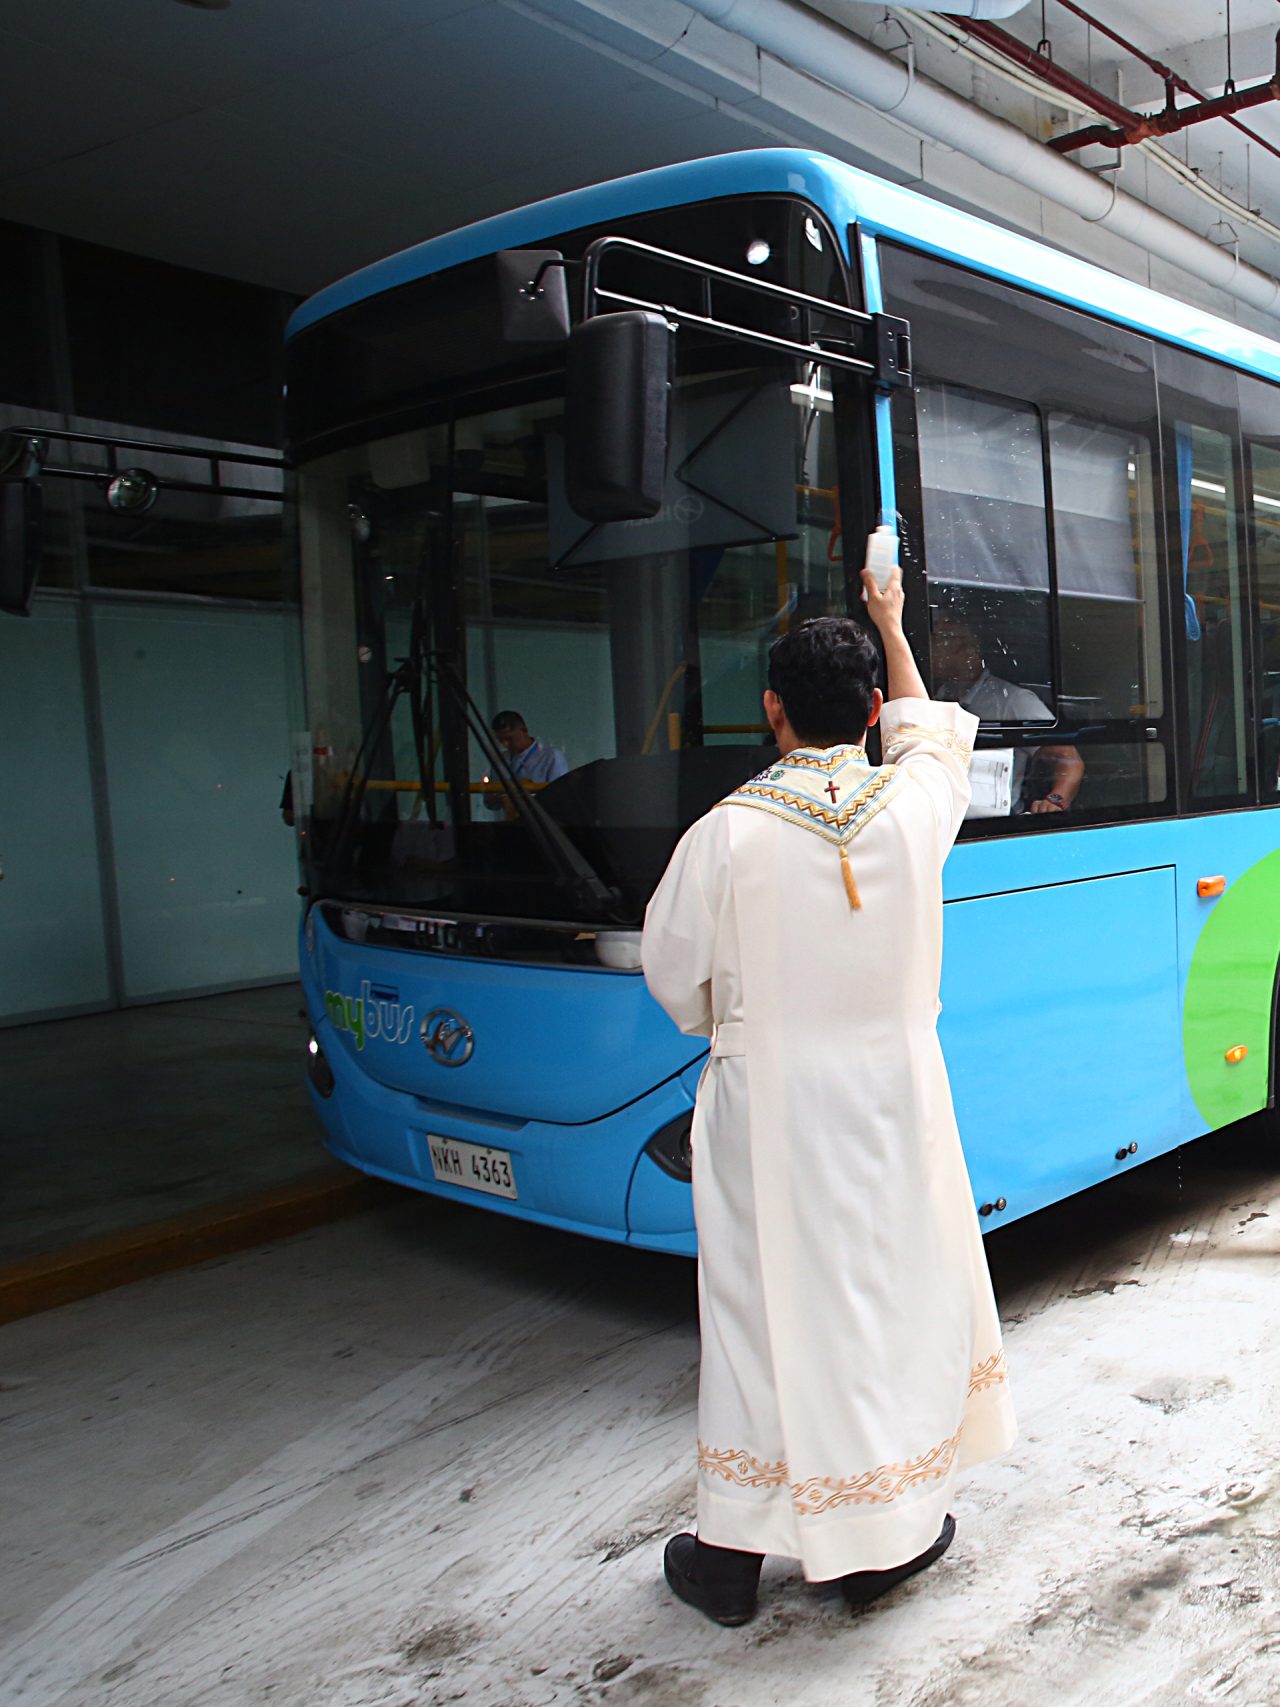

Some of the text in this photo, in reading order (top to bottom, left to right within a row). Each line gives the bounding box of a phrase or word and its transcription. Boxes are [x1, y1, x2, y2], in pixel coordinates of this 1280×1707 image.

[325, 979, 415, 1051] mybus
[432, 1146, 511, 1188] NKH 4363
